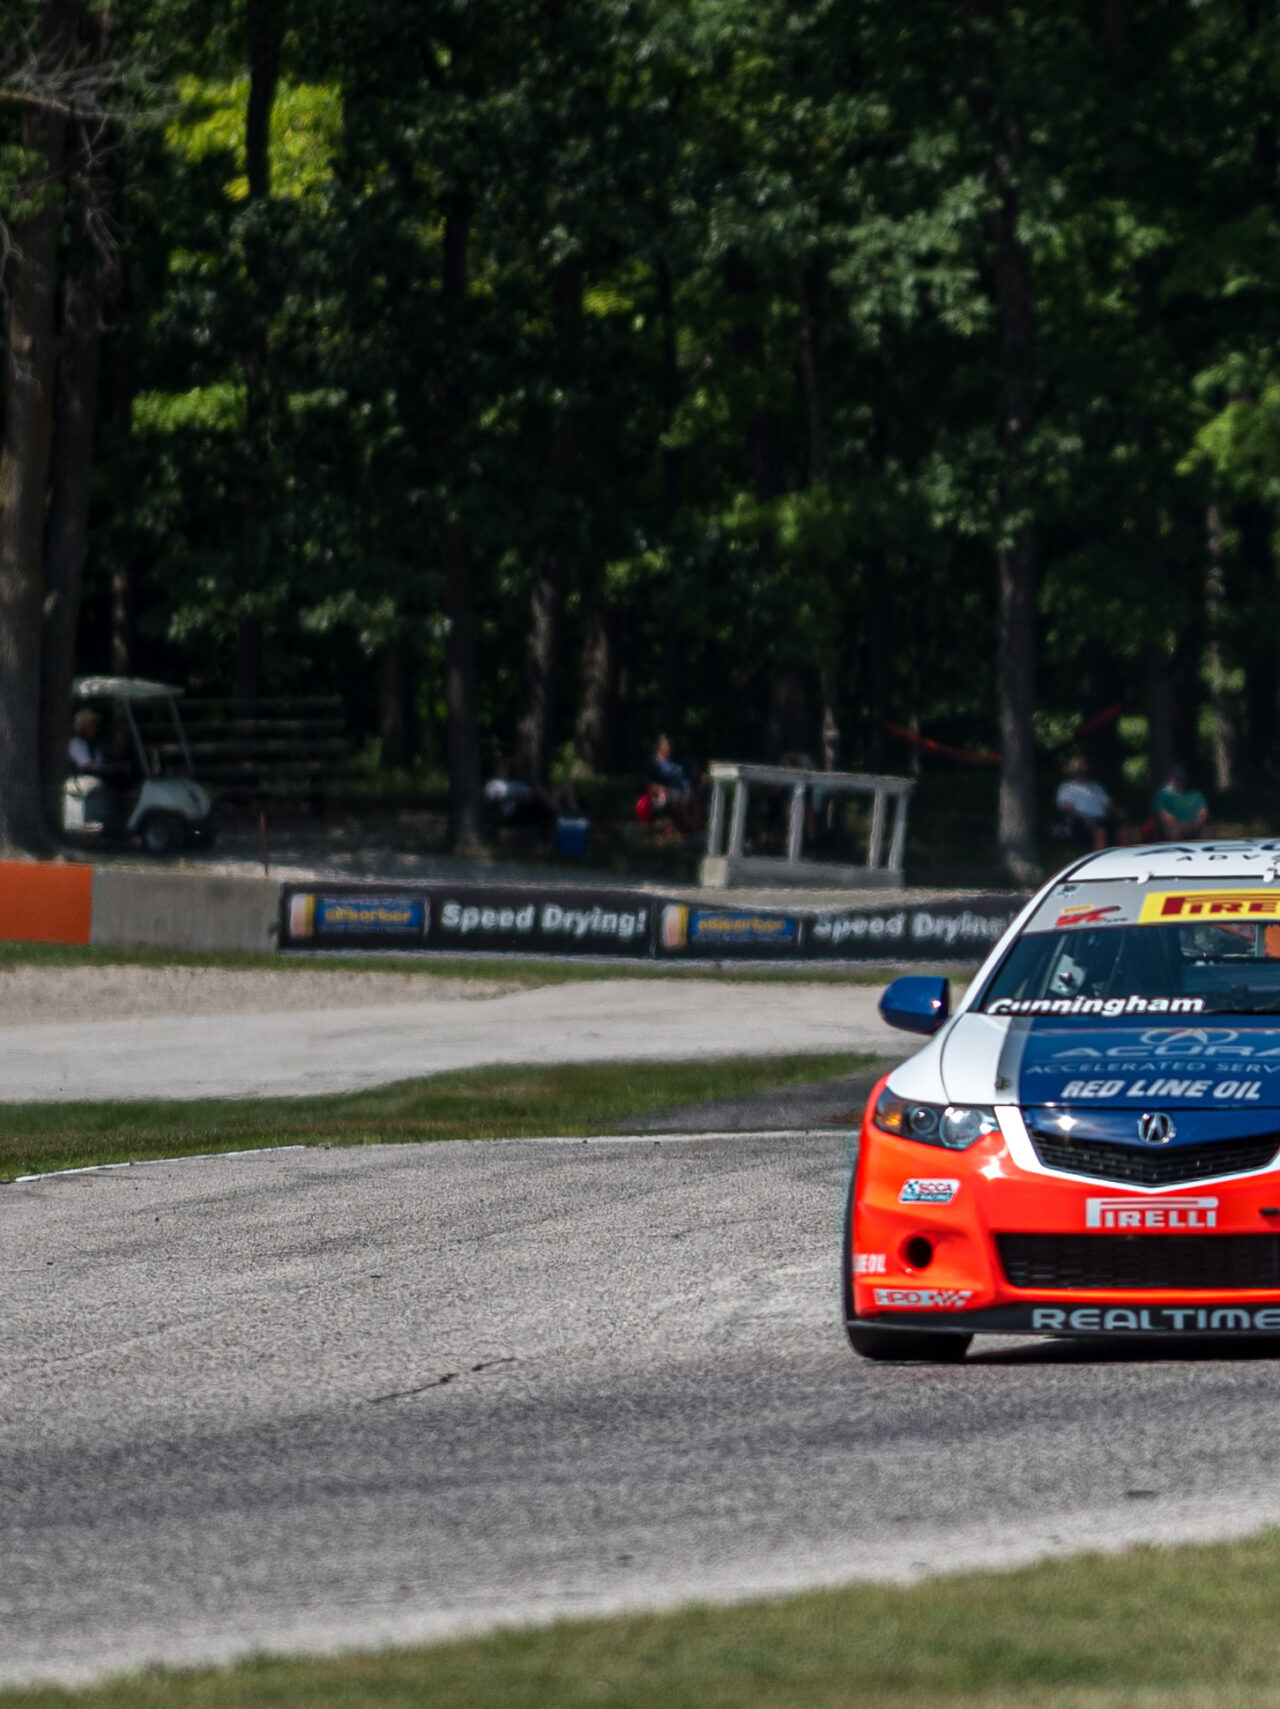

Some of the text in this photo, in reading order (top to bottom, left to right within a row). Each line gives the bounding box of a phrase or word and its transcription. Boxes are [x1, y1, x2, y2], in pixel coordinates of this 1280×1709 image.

[441, 902, 646, 938] Speed Drying!
[813, 908, 904, 943] Speed
[986, 996, 1205, 1017] Cunningham
[1025, 1061, 1205, 1074] ACCELERATED
[1060, 1078, 1262, 1100] RED LINE OIL
[1085, 1197, 1219, 1228] PIRELLI
